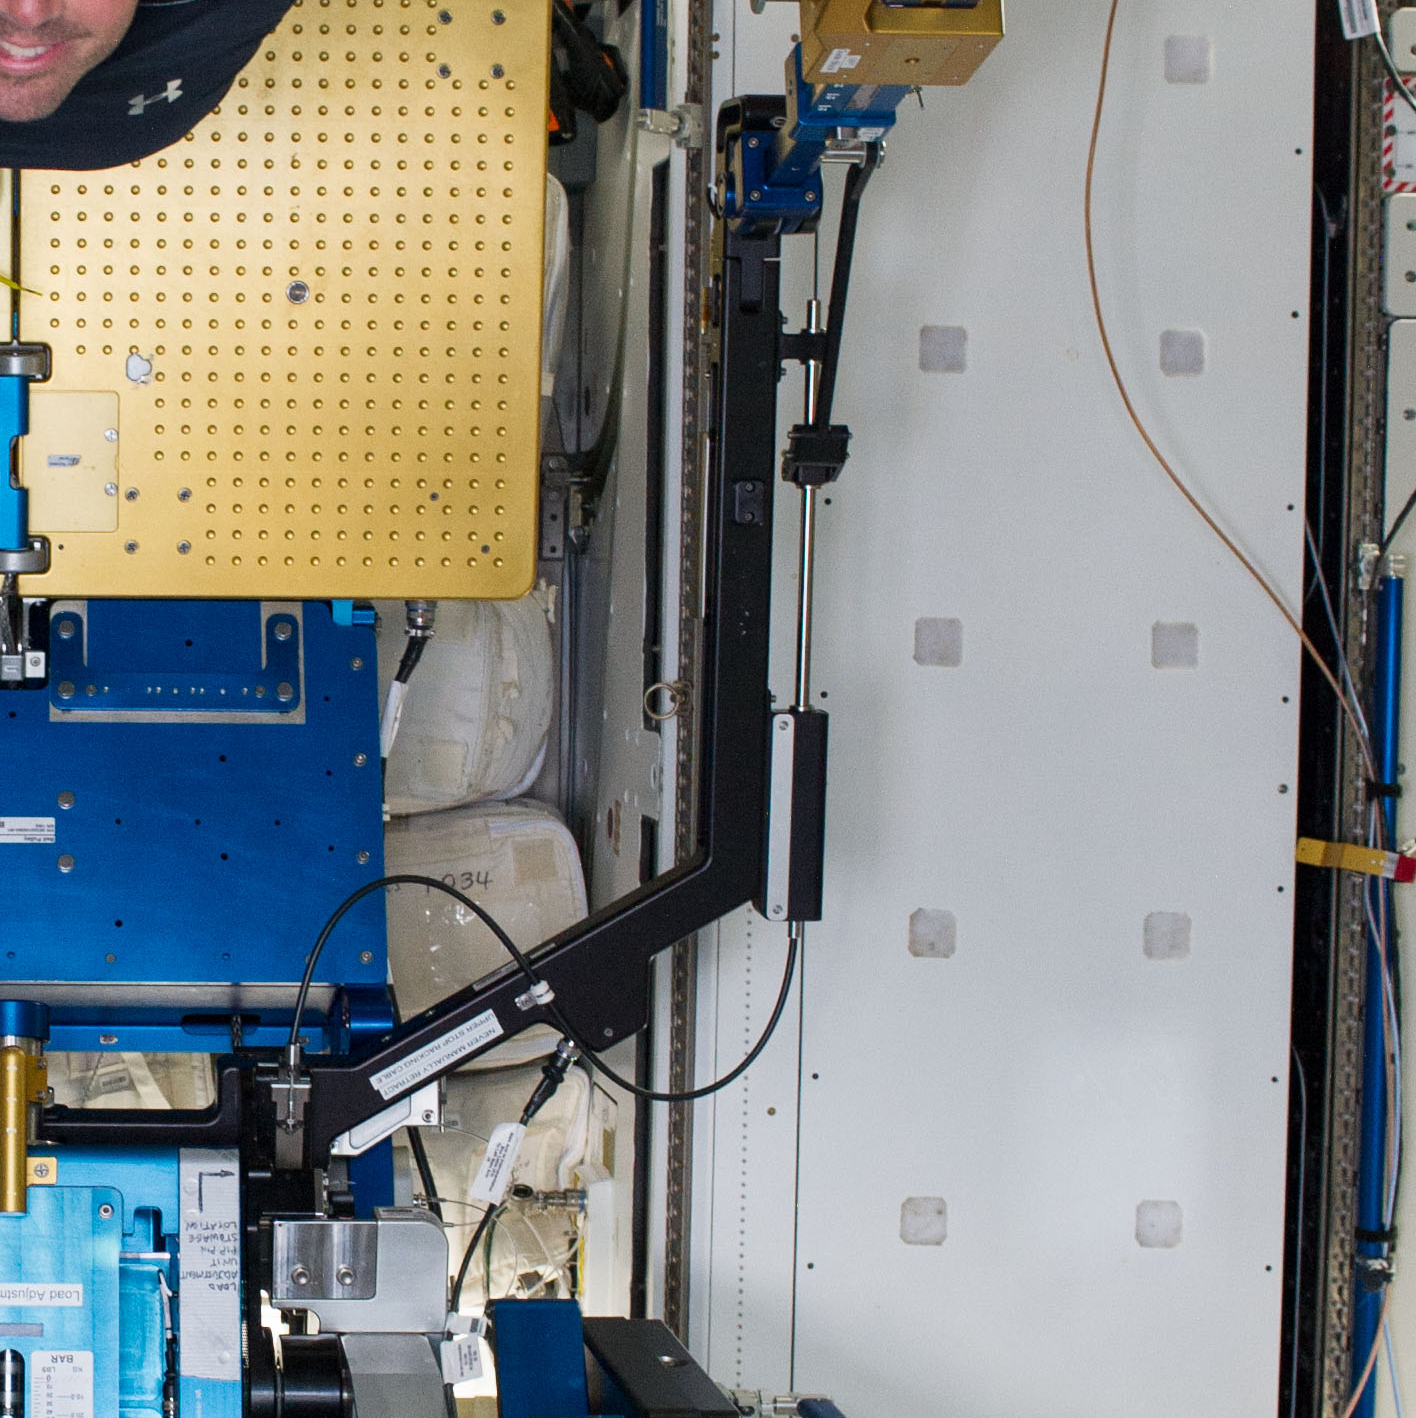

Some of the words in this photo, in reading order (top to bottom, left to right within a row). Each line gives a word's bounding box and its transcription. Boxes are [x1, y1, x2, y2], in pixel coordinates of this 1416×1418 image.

[465, 1012, 495, 1035] UPPER
[442, 1028, 465, 1046] STOP
[466, 1027, 496, 1049] NEVER
[402, 1042, 442, 1069] RACKING
[422, 1044, 466, 1076] MANUALLY
[375, 1063, 404, 1085] CABLE
[383, 1069, 421, 1096] RETRACT
[209, 1257, 238, 1267] UNIT
[179, 1269, 239, 1281] ADJUSTMENT
[49, 1290, 81, 1302] Load
[207, 1281, 237, 1292] LOAD
[50, 1354, 74, 1364] BAR
